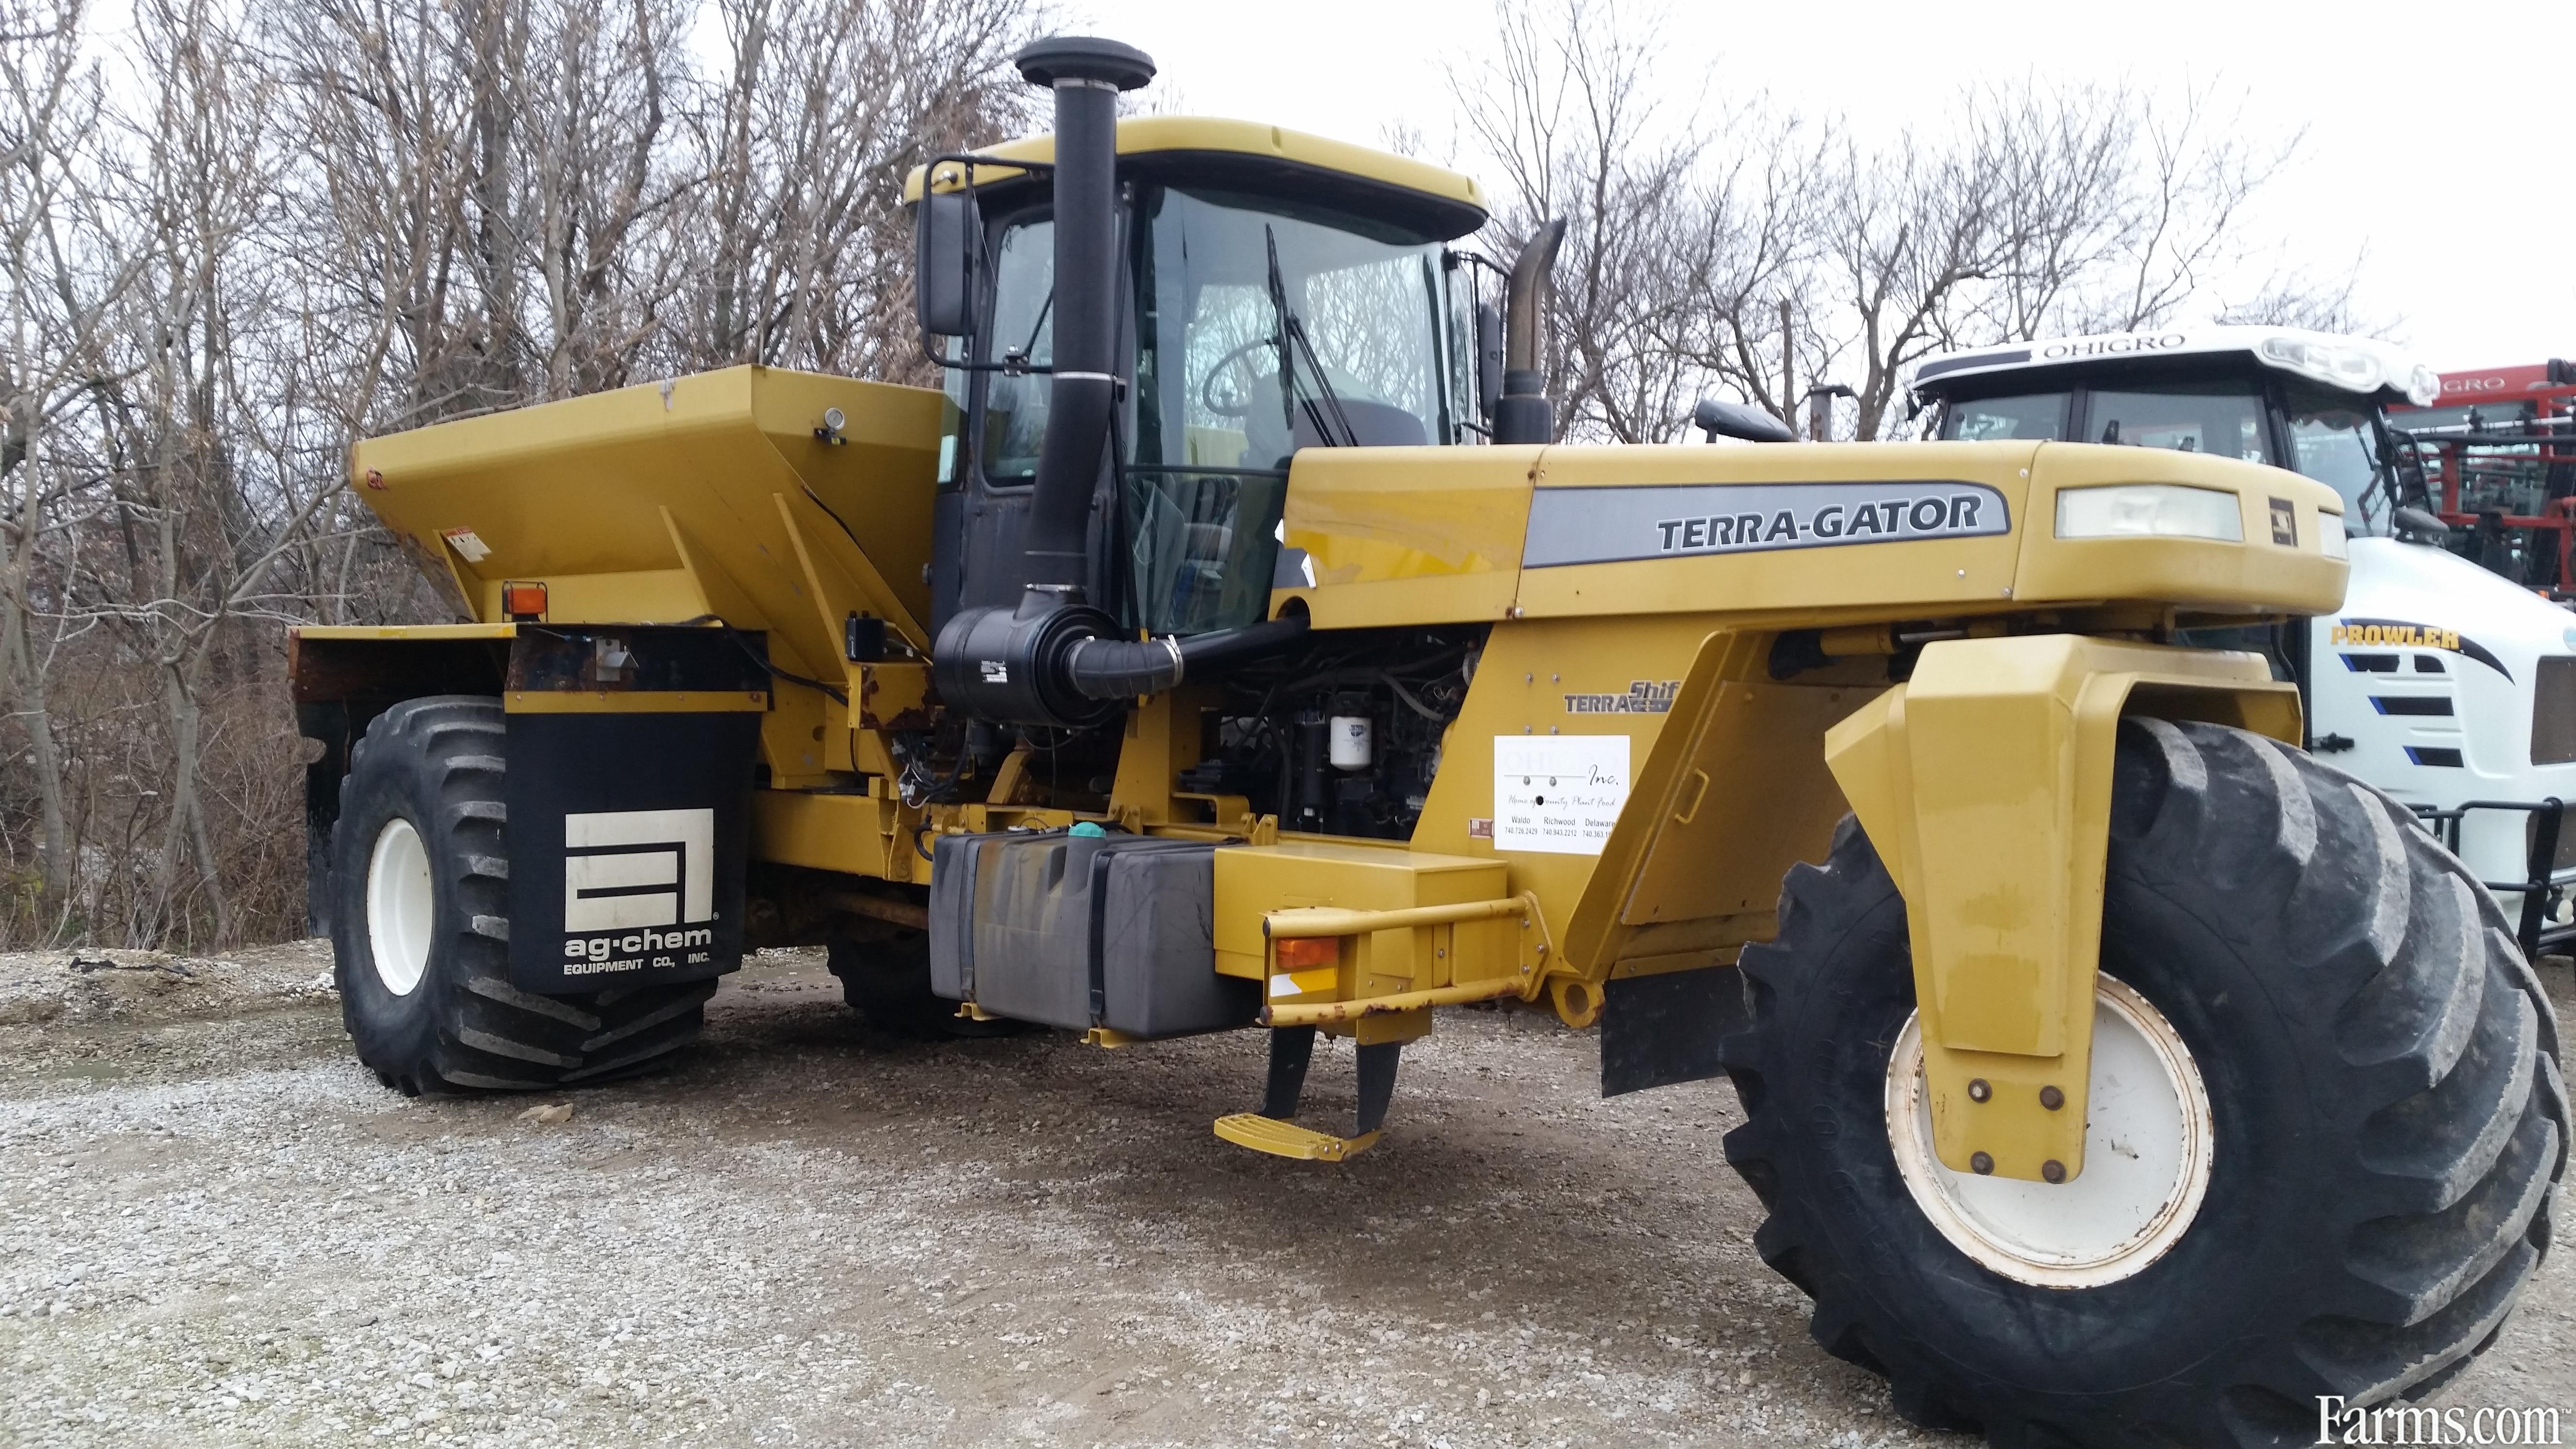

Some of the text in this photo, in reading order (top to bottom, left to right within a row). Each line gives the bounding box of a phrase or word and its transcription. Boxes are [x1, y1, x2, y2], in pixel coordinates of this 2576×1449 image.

[2044, 334, 2186, 358] OHIGRO
[1657, 493, 1982, 551] TERRA-GATOR
[2331, 624, 2461, 650] PROWLER
[1564, 680, 1681, 712] TERRA Shif
[1588, 764, 1619, 786] Inc.
[1544, 796, 1567, 810] ounty
[1512, 816, 1615, 827] Waldo Richwood Delaware
[1542, 828, 1577, 836] 740.943.2212
[564, 952, 710, 975] EQUIPMENT CO., INC.
